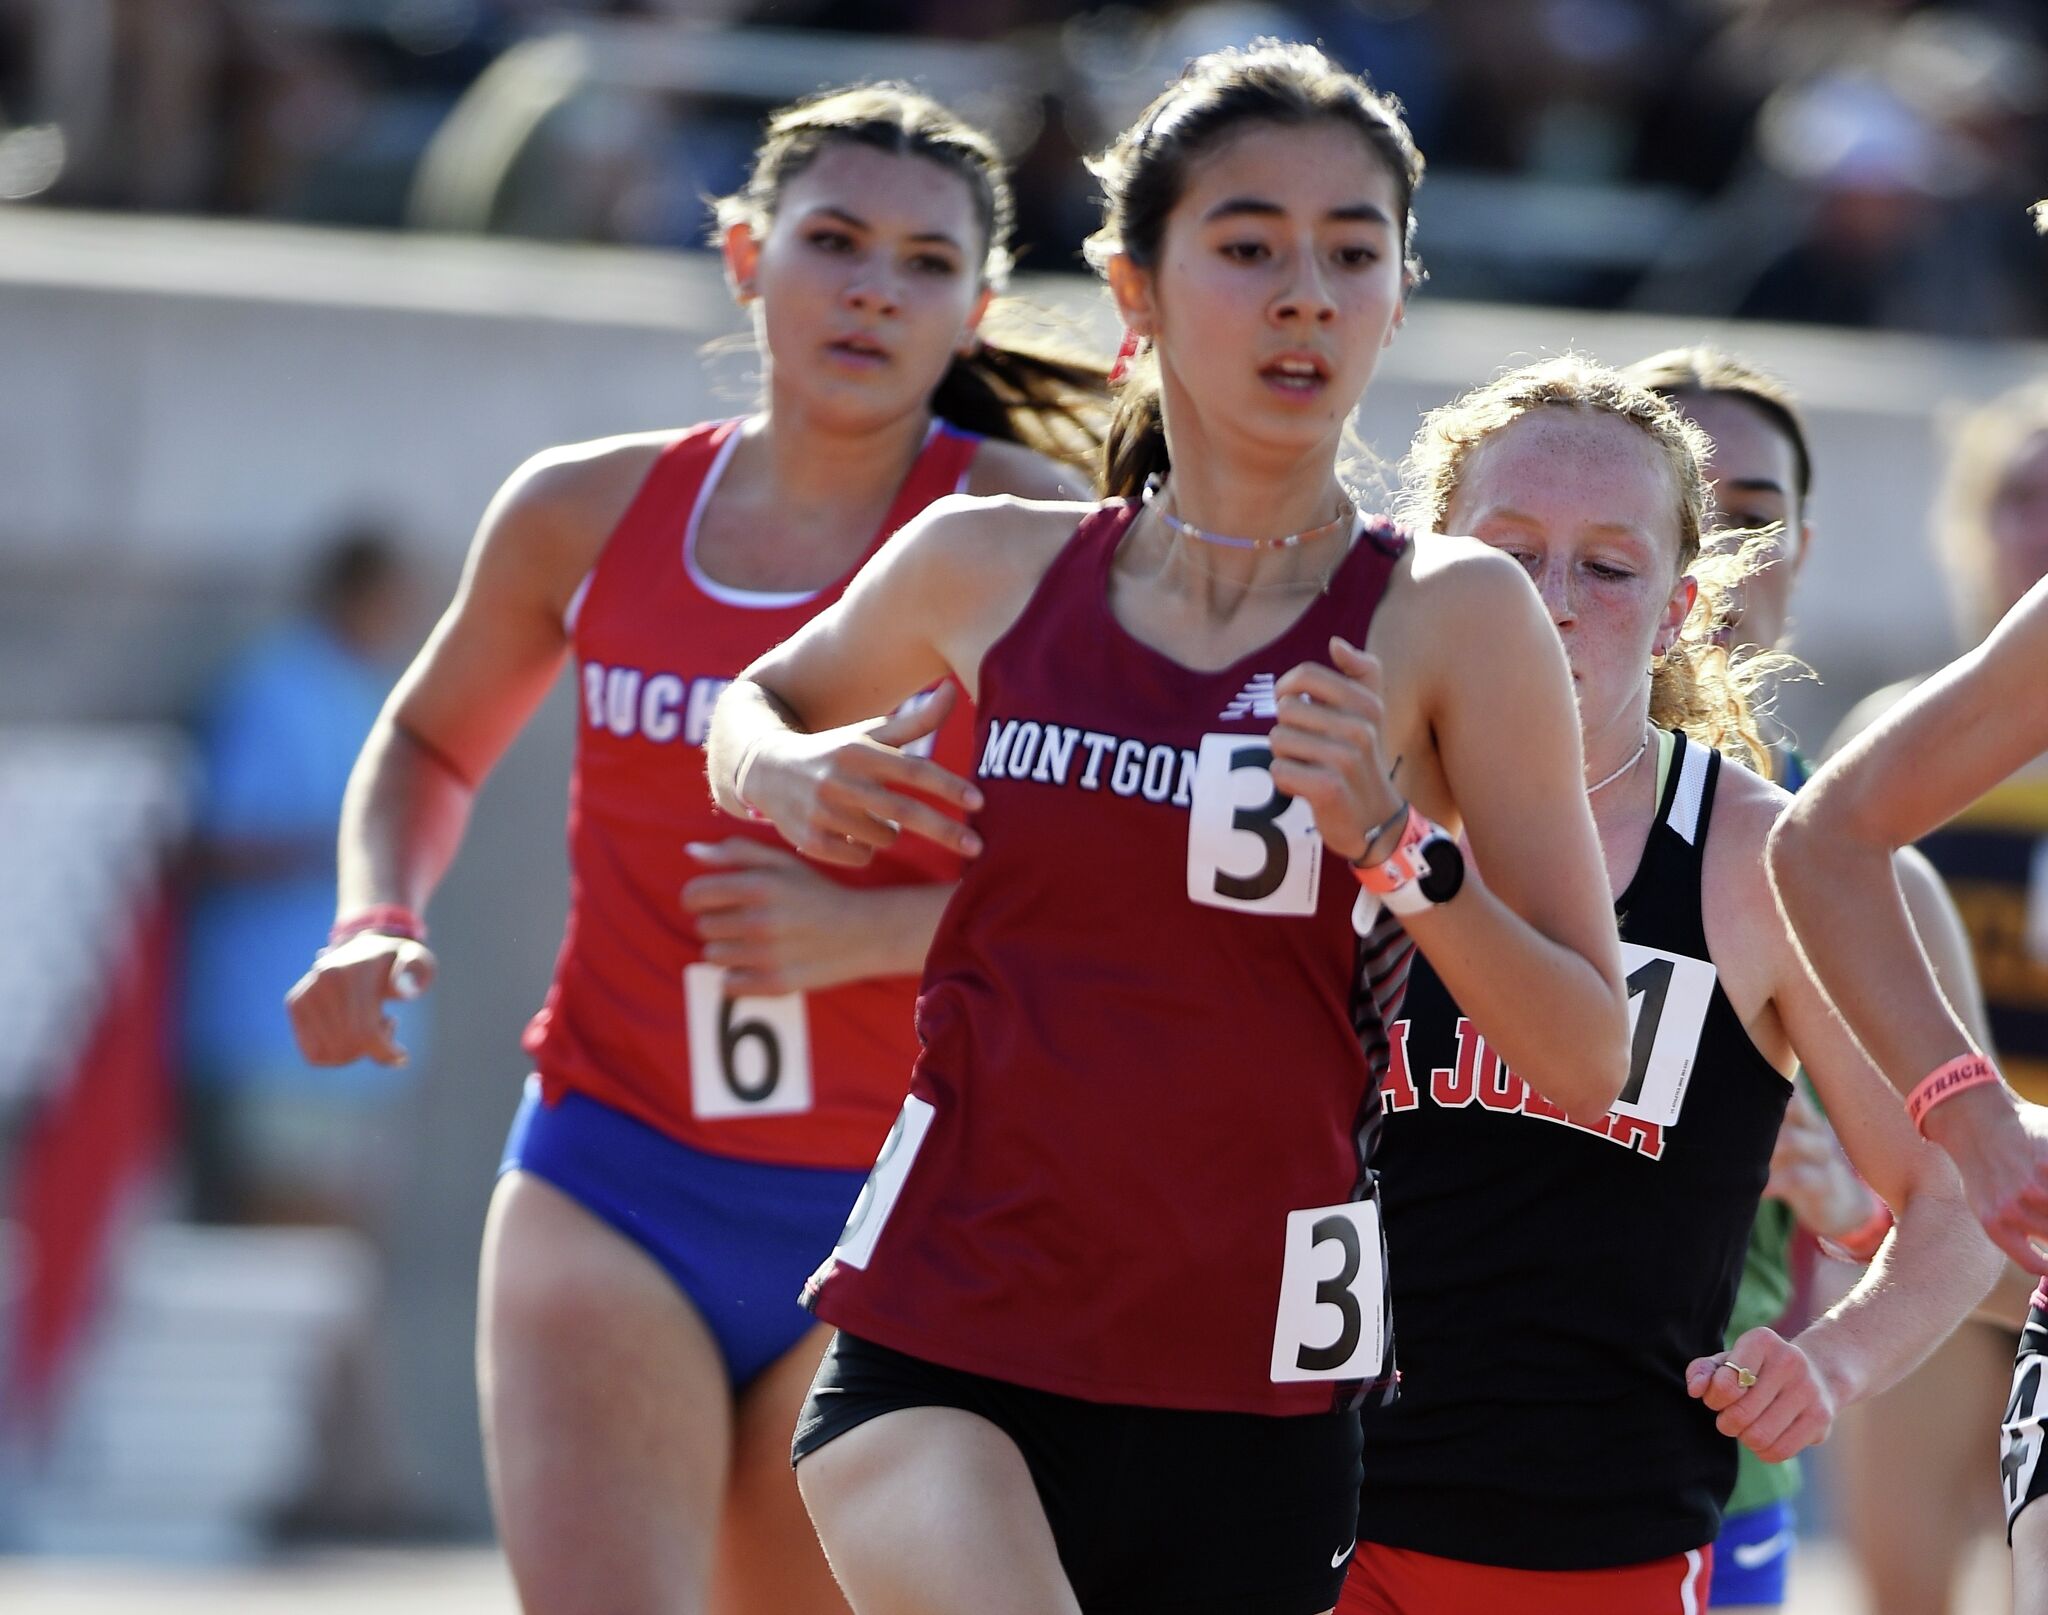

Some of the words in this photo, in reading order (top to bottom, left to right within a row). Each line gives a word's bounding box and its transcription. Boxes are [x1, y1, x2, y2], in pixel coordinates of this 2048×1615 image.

[1213, 744, 1294, 901] 3
[720, 996, 782, 1103] 6
[1618, 957, 1676, 1106] 1
[1294, 1213, 1362, 1371] 3
